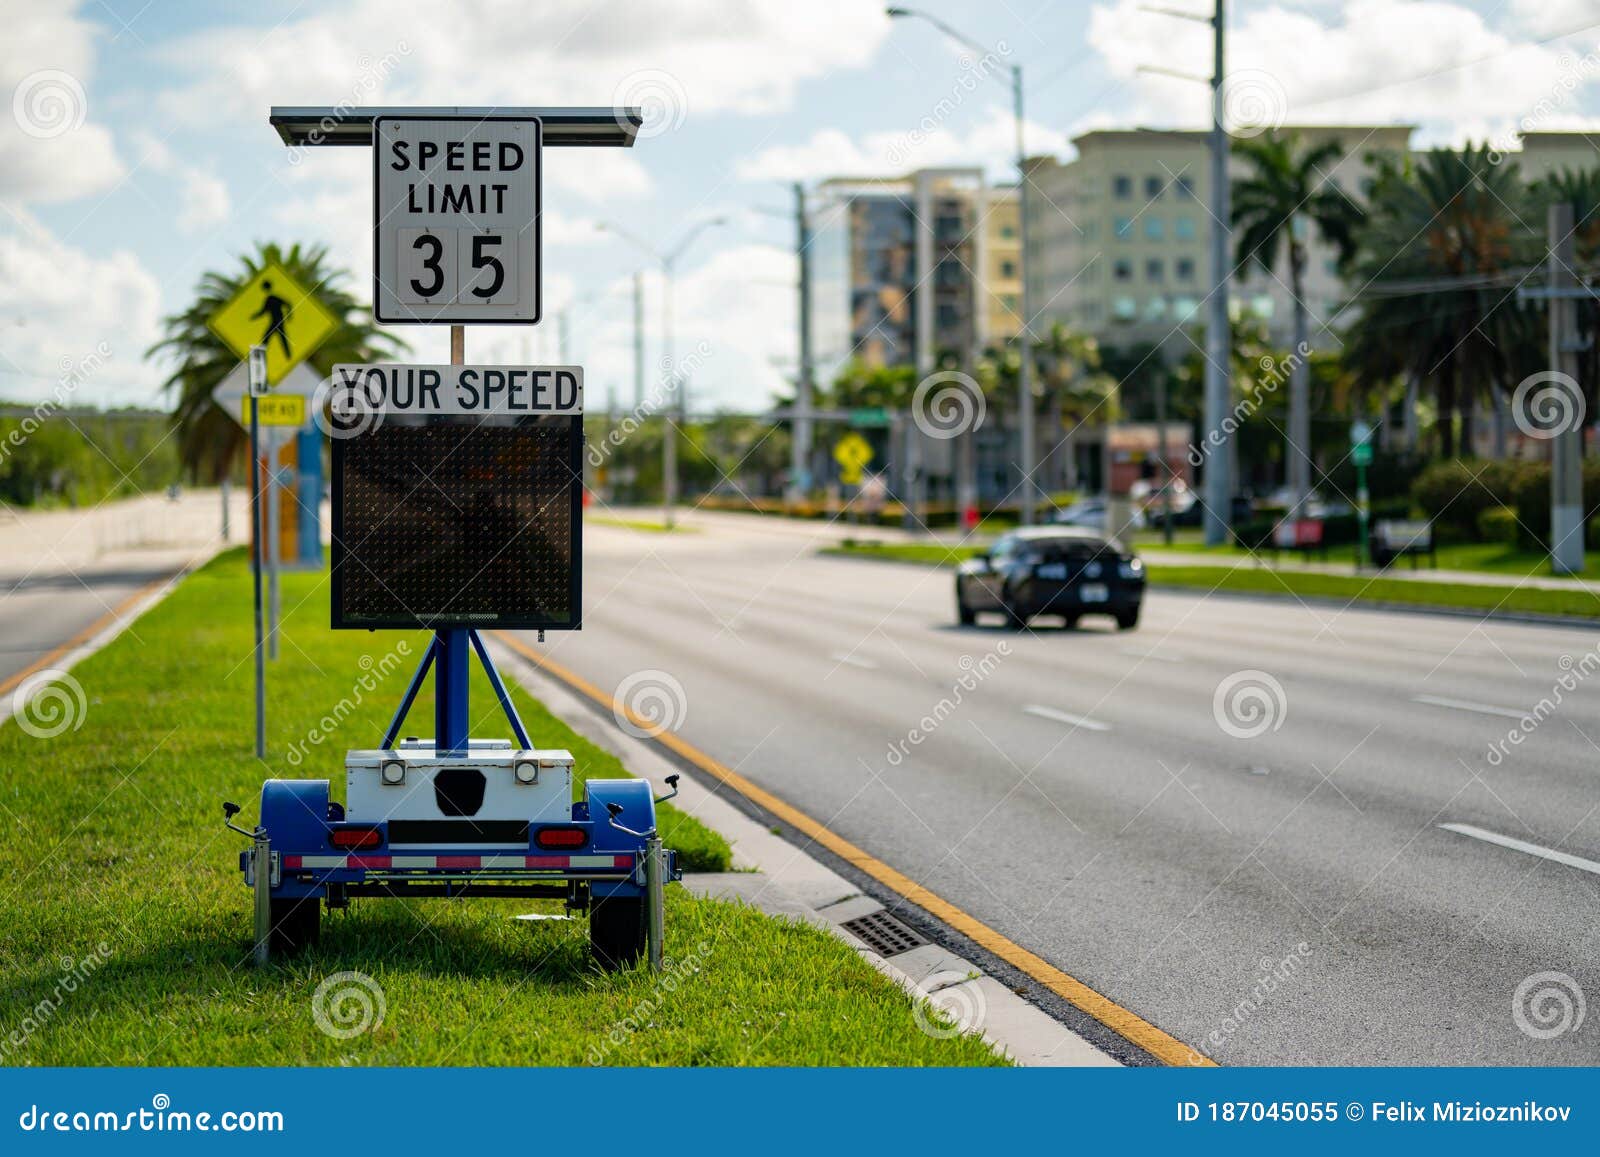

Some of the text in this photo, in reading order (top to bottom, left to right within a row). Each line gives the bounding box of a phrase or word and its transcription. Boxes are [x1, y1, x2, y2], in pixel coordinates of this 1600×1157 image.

[391, 140, 525, 172] SPEED
[408, 183, 509, 214] LIMIT
[409, 234, 505, 299] 35
[338, 367, 578, 411] YOUR SPEED
